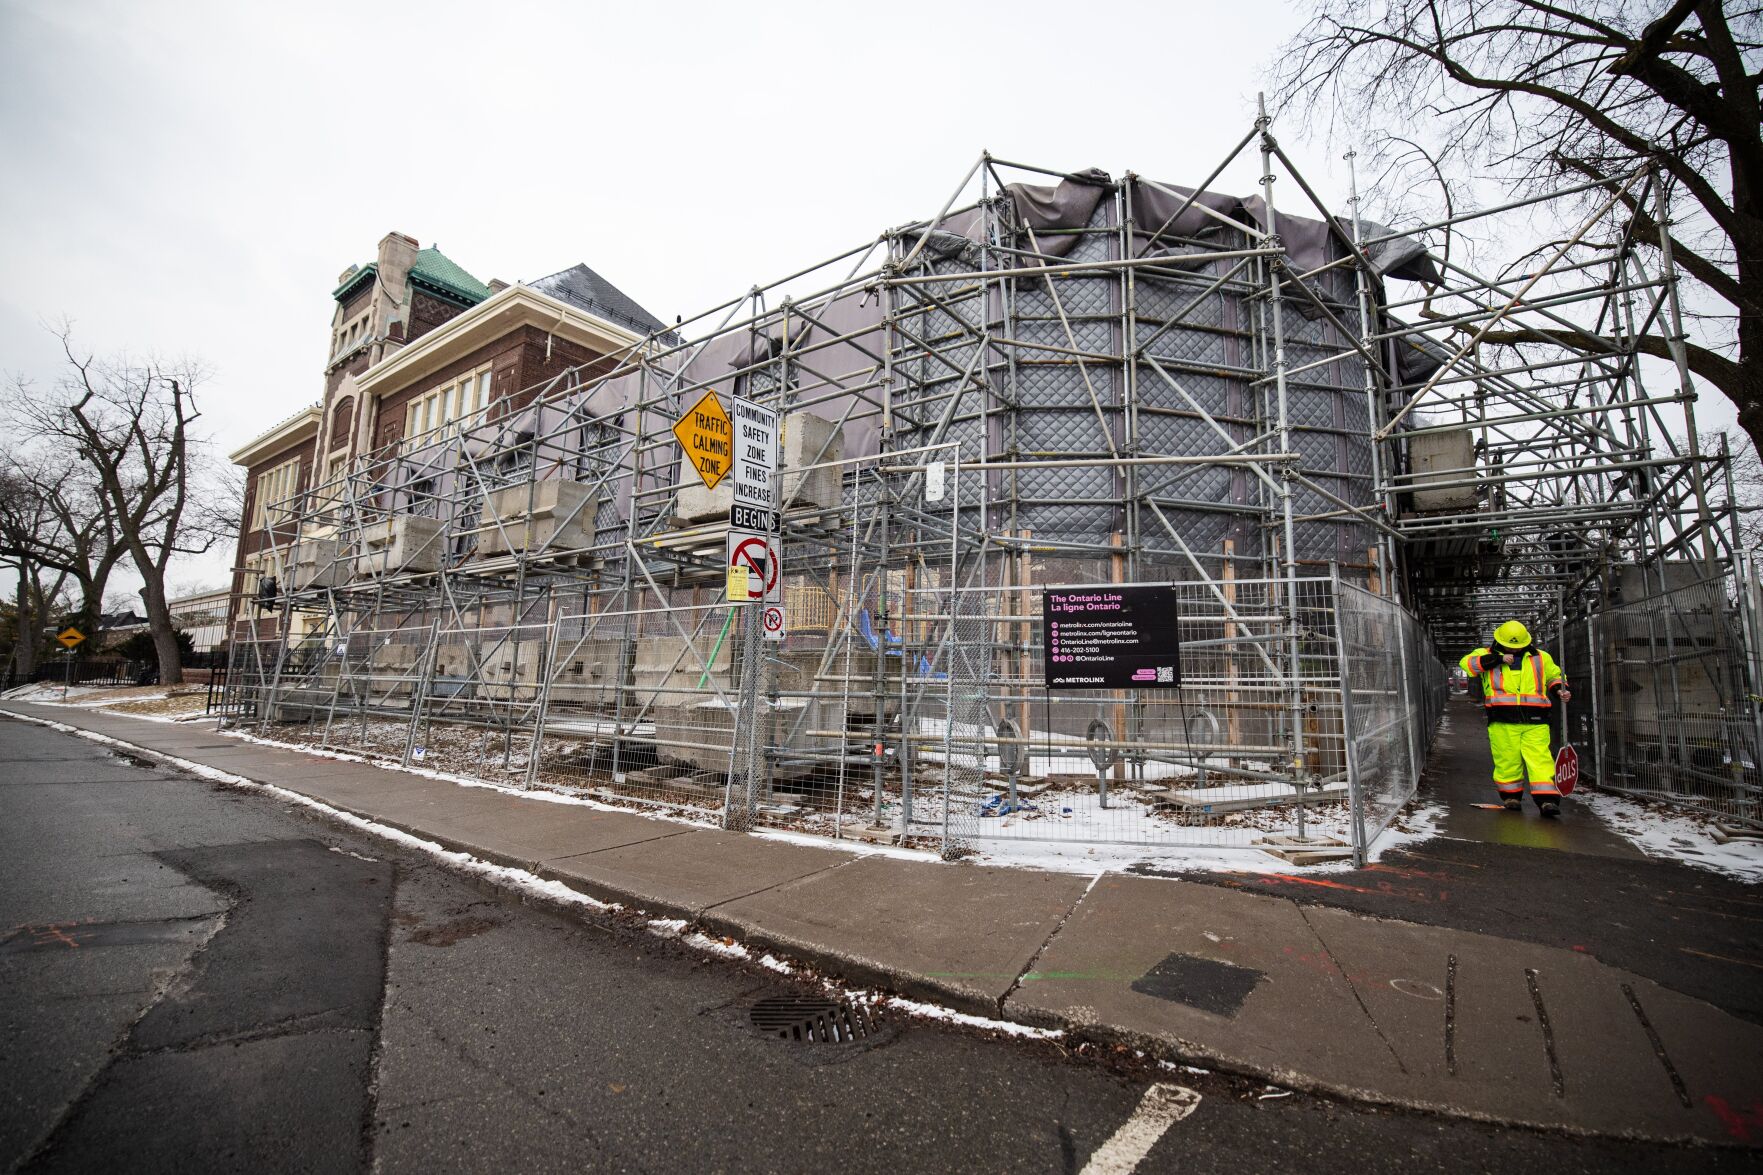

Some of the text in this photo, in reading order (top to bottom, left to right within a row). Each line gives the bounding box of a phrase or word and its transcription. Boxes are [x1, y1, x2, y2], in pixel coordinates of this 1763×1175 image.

[695, 412, 727, 435] TRAFFIC
[736, 404, 774, 429] COMMUNITY
[743, 425, 769, 444] SAFETY
[693, 433, 728, 456] CALMING
[747, 445, 765, 462] ZONE
[700, 457, 720, 476] ZONE
[745, 466, 766, 483] FINES
[1063, 603, 1084, 612] ligne
[1069, 594, 1102, 602] Ontario
[1557, 760, 1576, 783] STOP
